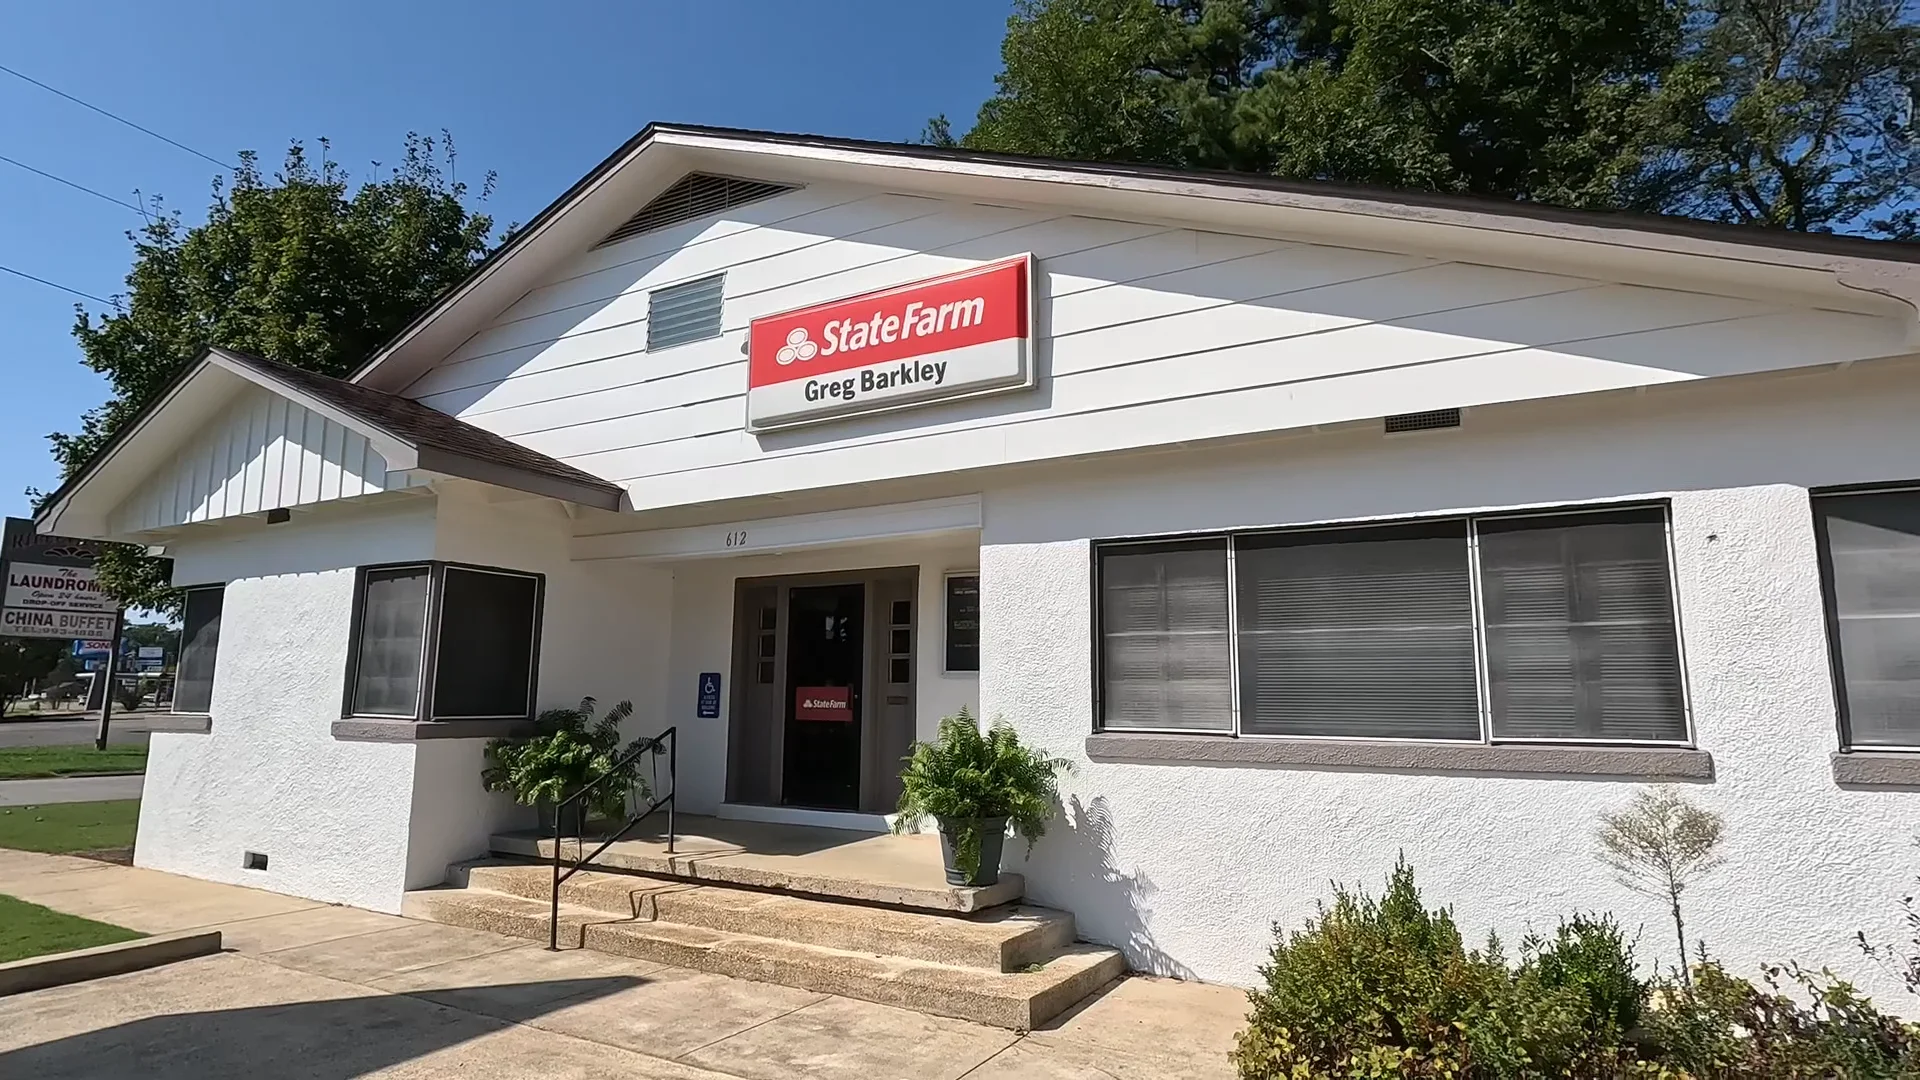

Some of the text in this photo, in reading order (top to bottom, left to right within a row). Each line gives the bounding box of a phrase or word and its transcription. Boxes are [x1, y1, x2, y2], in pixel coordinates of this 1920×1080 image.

[804, 361, 948, 401] Greg Barkley
[726, 531, 747, 547] 612
[58, 568, 78, 578] The
[10, 573, 104, 593] LAUNDROM
[68, 602, 103, 610] SERVICE
[5, 611, 115, 630] CHINA BUFFET
[85, 641, 110, 650] SON
